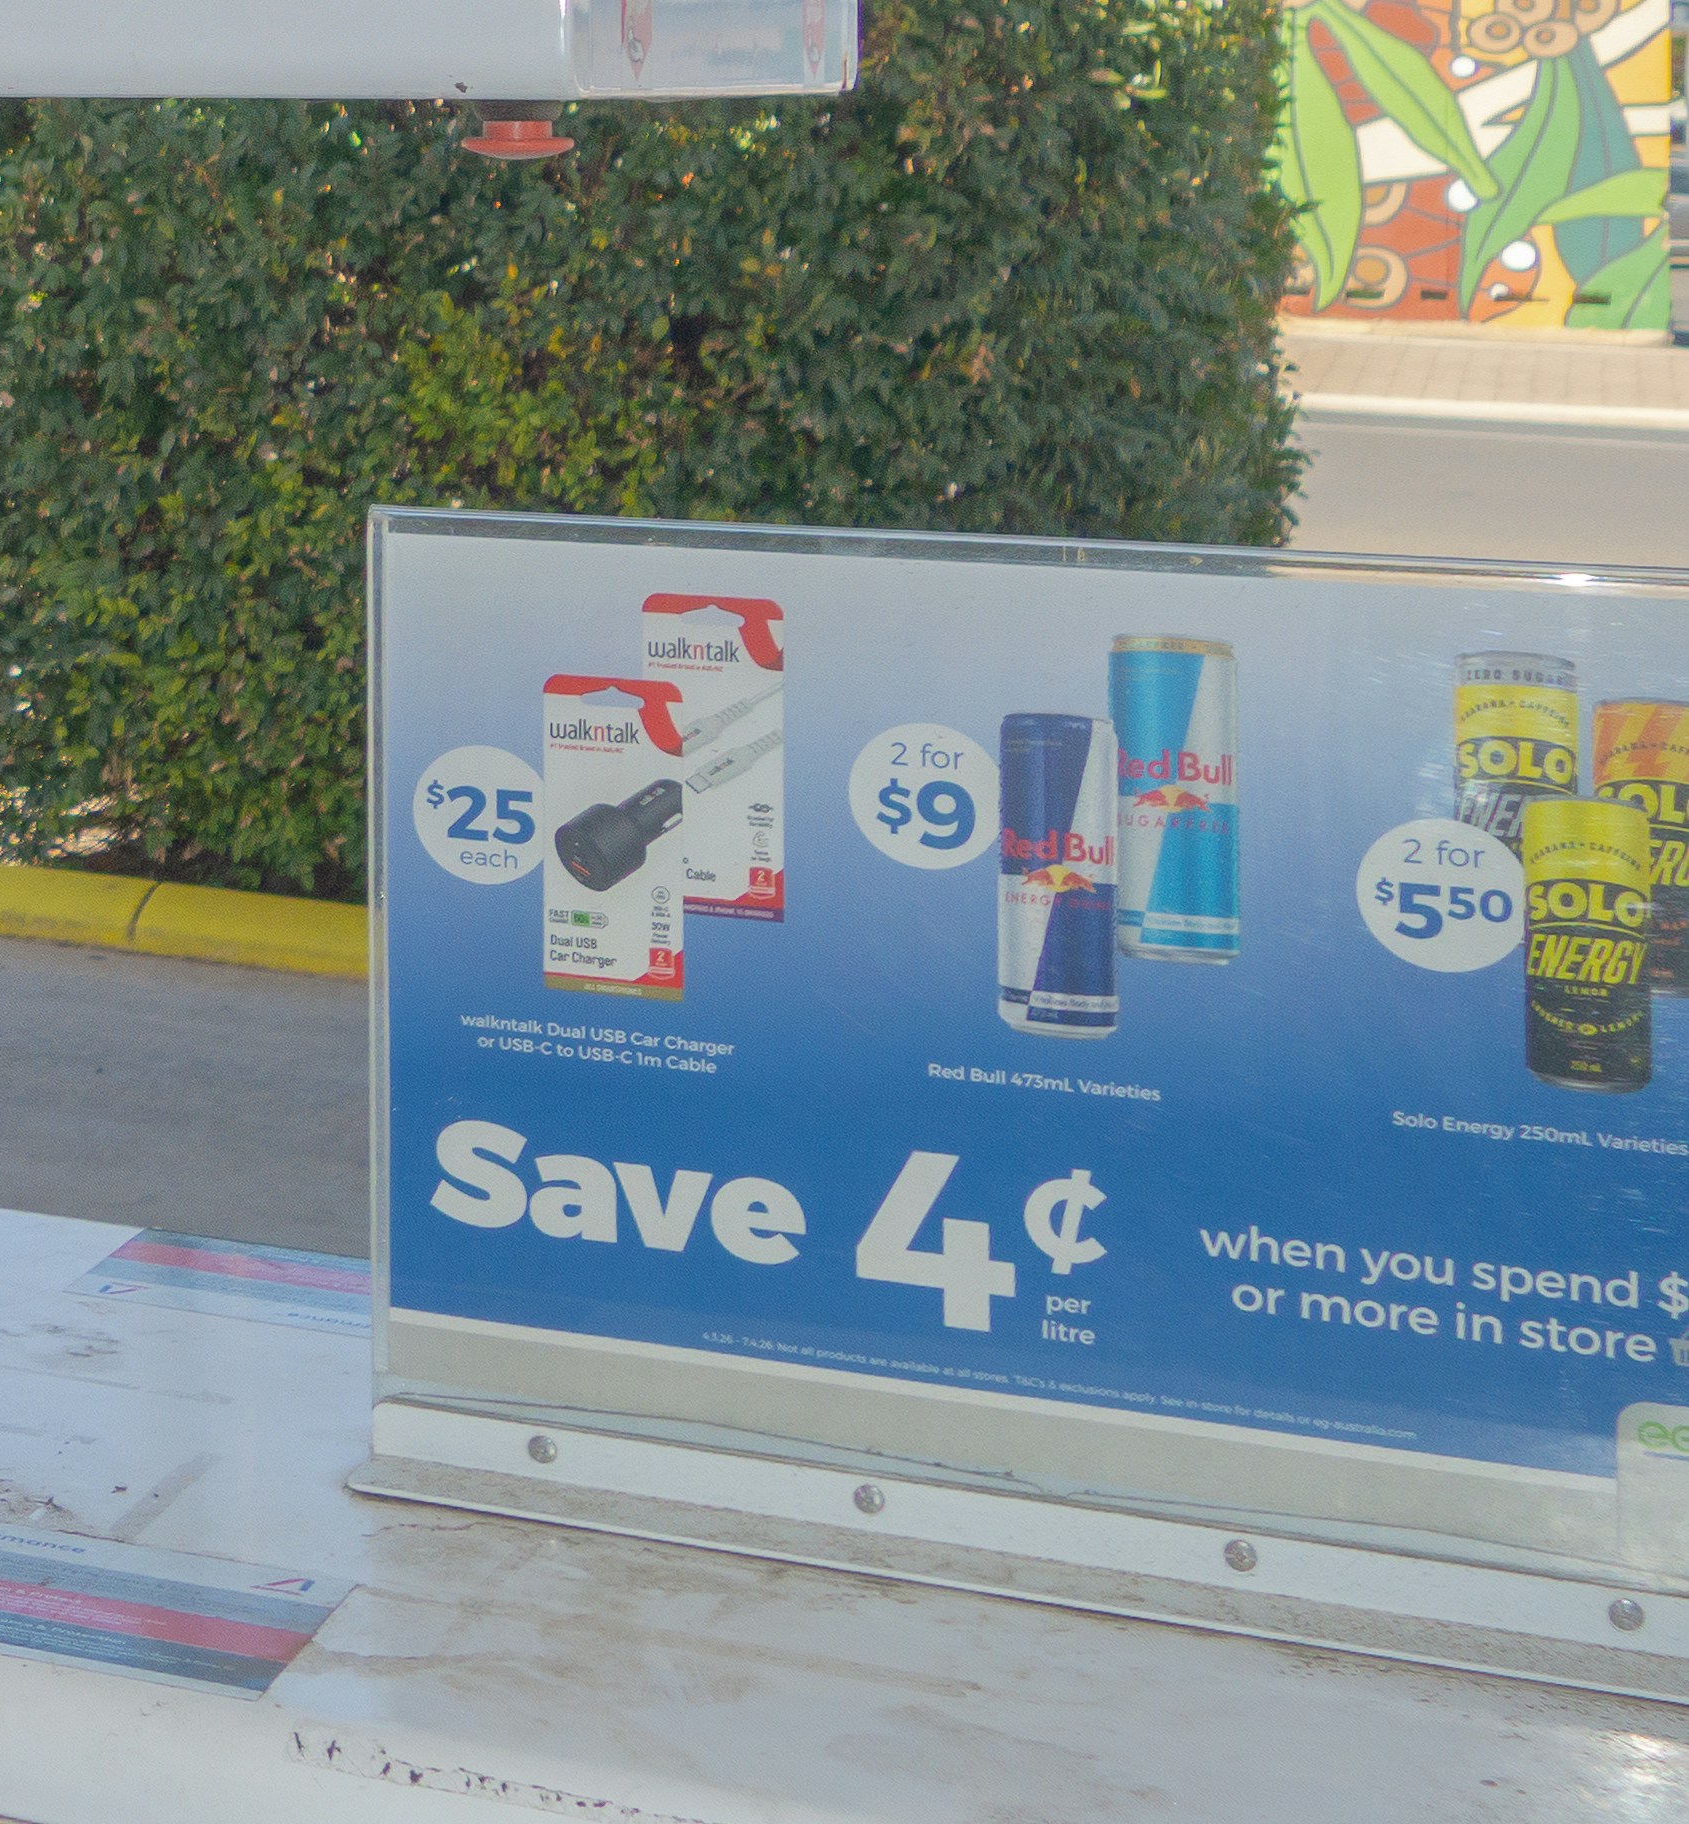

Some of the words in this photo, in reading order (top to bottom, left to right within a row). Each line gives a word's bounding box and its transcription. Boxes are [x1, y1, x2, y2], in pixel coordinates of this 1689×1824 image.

[647, 637, 740, 664] walkntalk
[549, 719, 640, 746] walkntalk
[891, 742, 908, 766] 2
[920, 743, 964, 771] for
[1458, 739, 1576, 783] SOLO
[426, 779, 536, 845] $25
[876, 777, 976, 851] $9
[459, 848, 518, 869] each
[1002, 828, 1057, 861] Red
[1064, 832, 1115, 867] Bull
[1528, 882, 1647, 927] SOLO
[1527, 934, 1649, 985] ENERGY
[460, 1014, 543, 1035] walkntalk
[547, 1023, 586, 1040] Dual
[590, 1027, 627, 1044] USB
[630, 1031, 660, 1048] Car
[664, 1035, 735, 1057] Charger
[928, 1062, 965, 1081] Red
[970, 1065, 1006, 1085] Bull
[1010, 1071, 1074, 1093] 473mL
[1078, 1079, 1162, 1102] Varieties
[1392, 1110, 1439, 1130] Solo
[1443, 1115, 1514, 1141] Energy
[1520, 1124, 1592, 1148] 250mL
[1597, 1132, 1688, 1157] Varieties
[429, 1119, 808, 1266] Save
[1200, 1225, 1347, 1273] when
[1360, 1247, 1455, 1286] you
[1472, 1261, 1640, 1310] spend
[1045, 1293, 1092, 1318] per
[1231, 1283, 1285, 1315] or
[1300, 1290, 1440, 1335] more
[1456, 1302, 1503, 1344] in
[1519, 1322, 1657, 1362] store
[1041, 1319, 1097, 1346] litre
